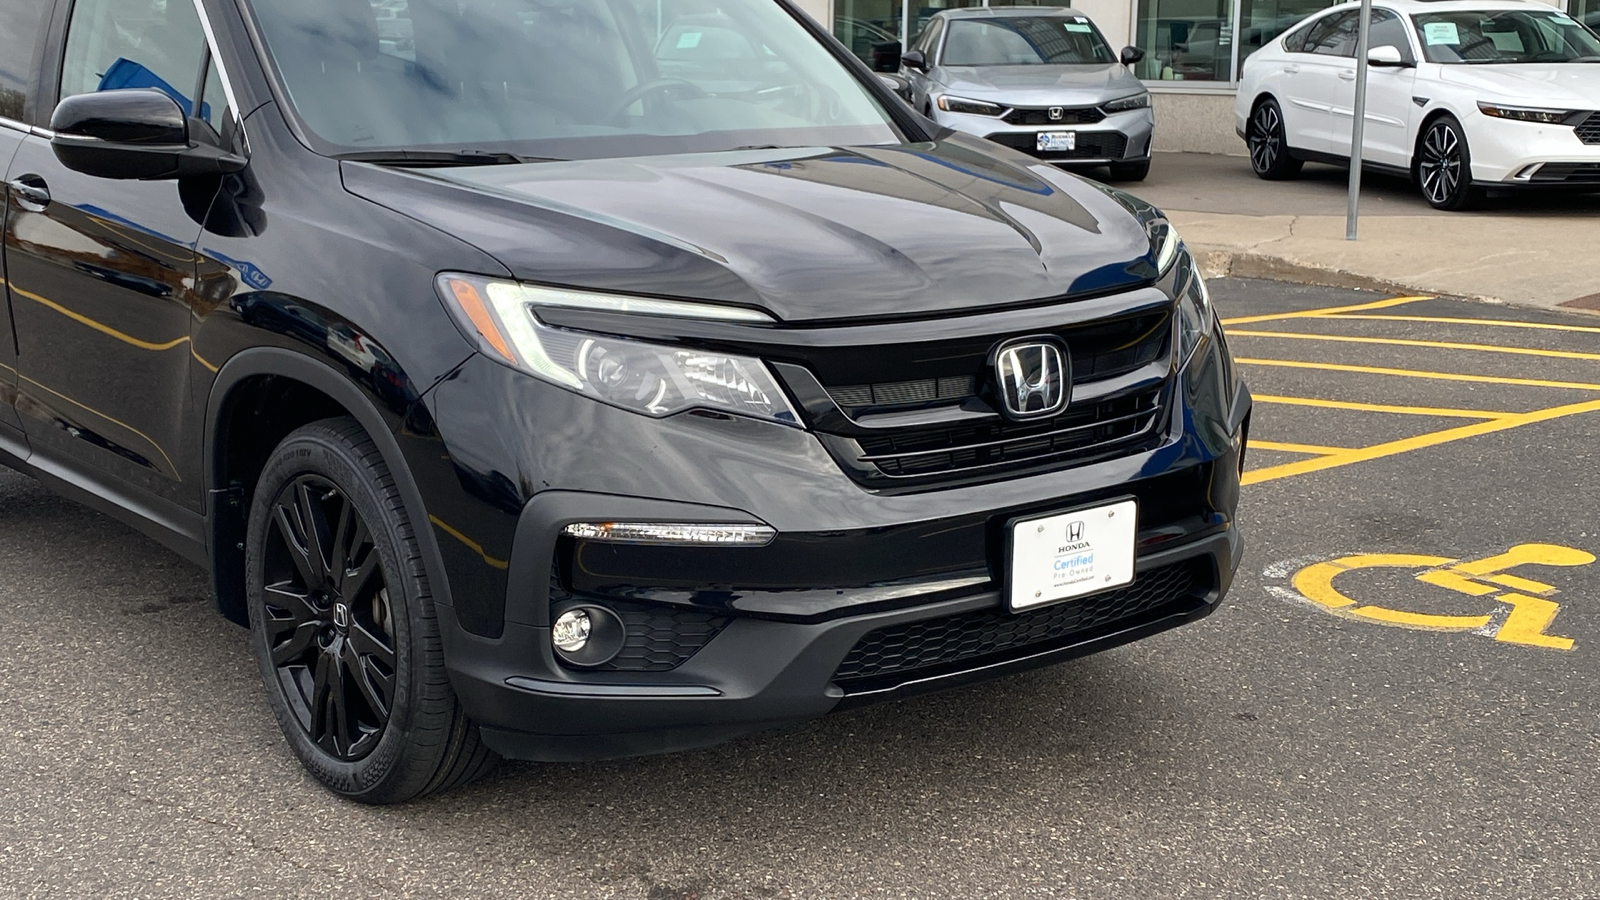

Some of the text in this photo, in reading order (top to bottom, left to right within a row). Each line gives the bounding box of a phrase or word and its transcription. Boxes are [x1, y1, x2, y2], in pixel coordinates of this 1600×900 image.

[1051, 139, 1074, 147] HONDA
[1058, 541, 1091, 554] HONDA
[1053, 553, 1094, 571] Certified
